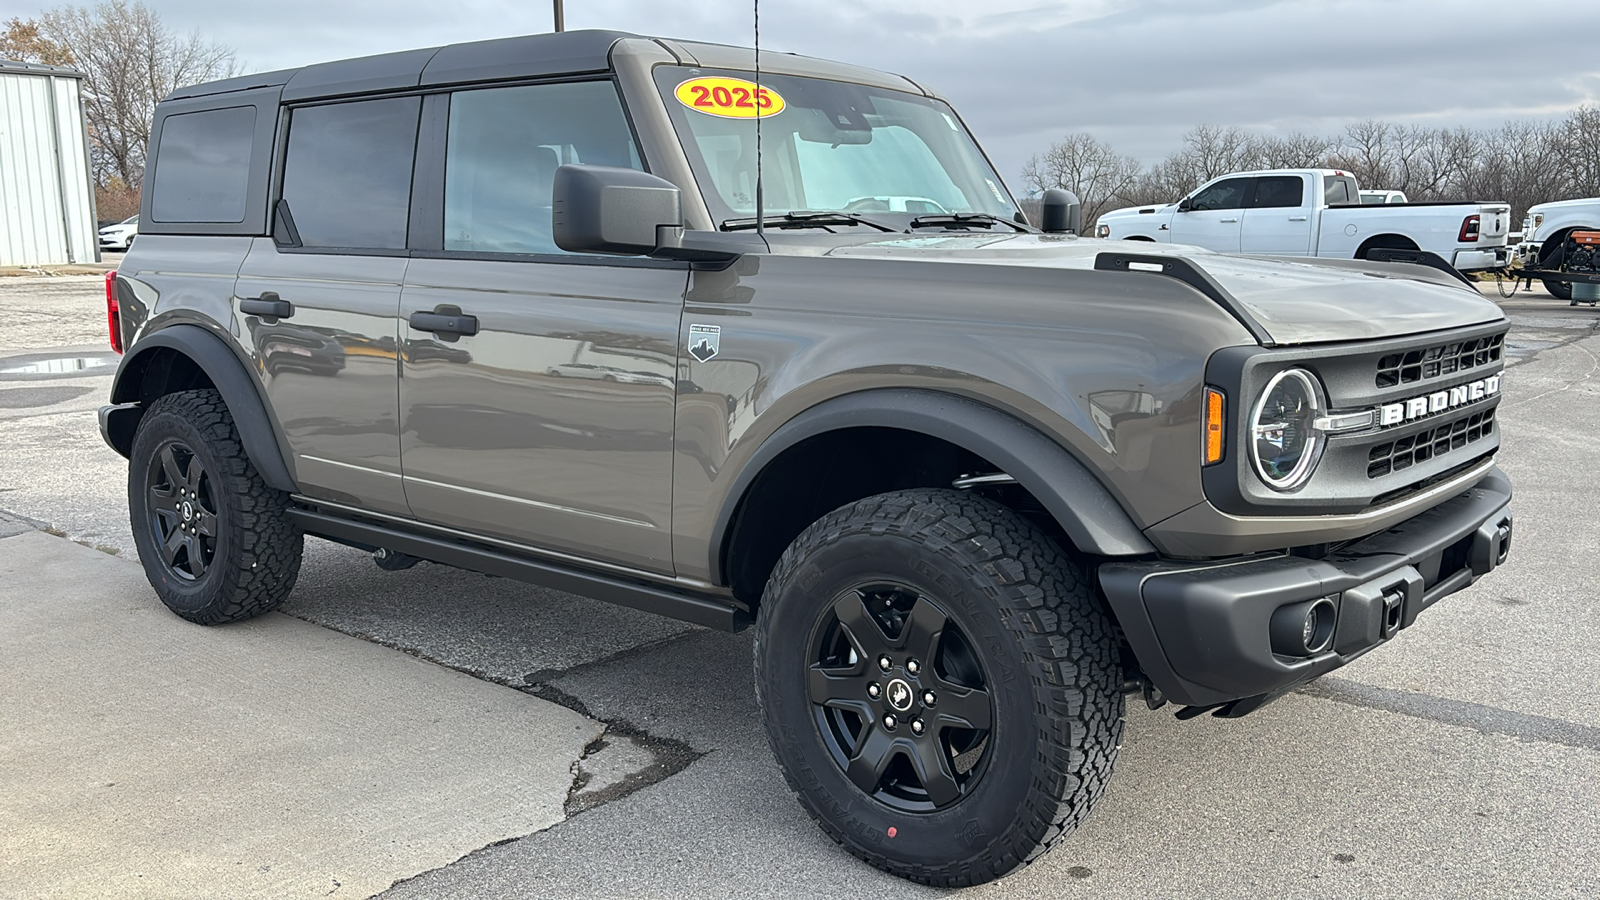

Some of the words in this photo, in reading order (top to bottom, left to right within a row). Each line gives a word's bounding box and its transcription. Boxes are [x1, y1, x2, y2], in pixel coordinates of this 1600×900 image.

[690, 85, 773, 109] 2025
[1380, 375, 1501, 426] BRONCO
[915, 559, 1020, 706] GENERAL
[781, 722, 885, 846] GRABBER
